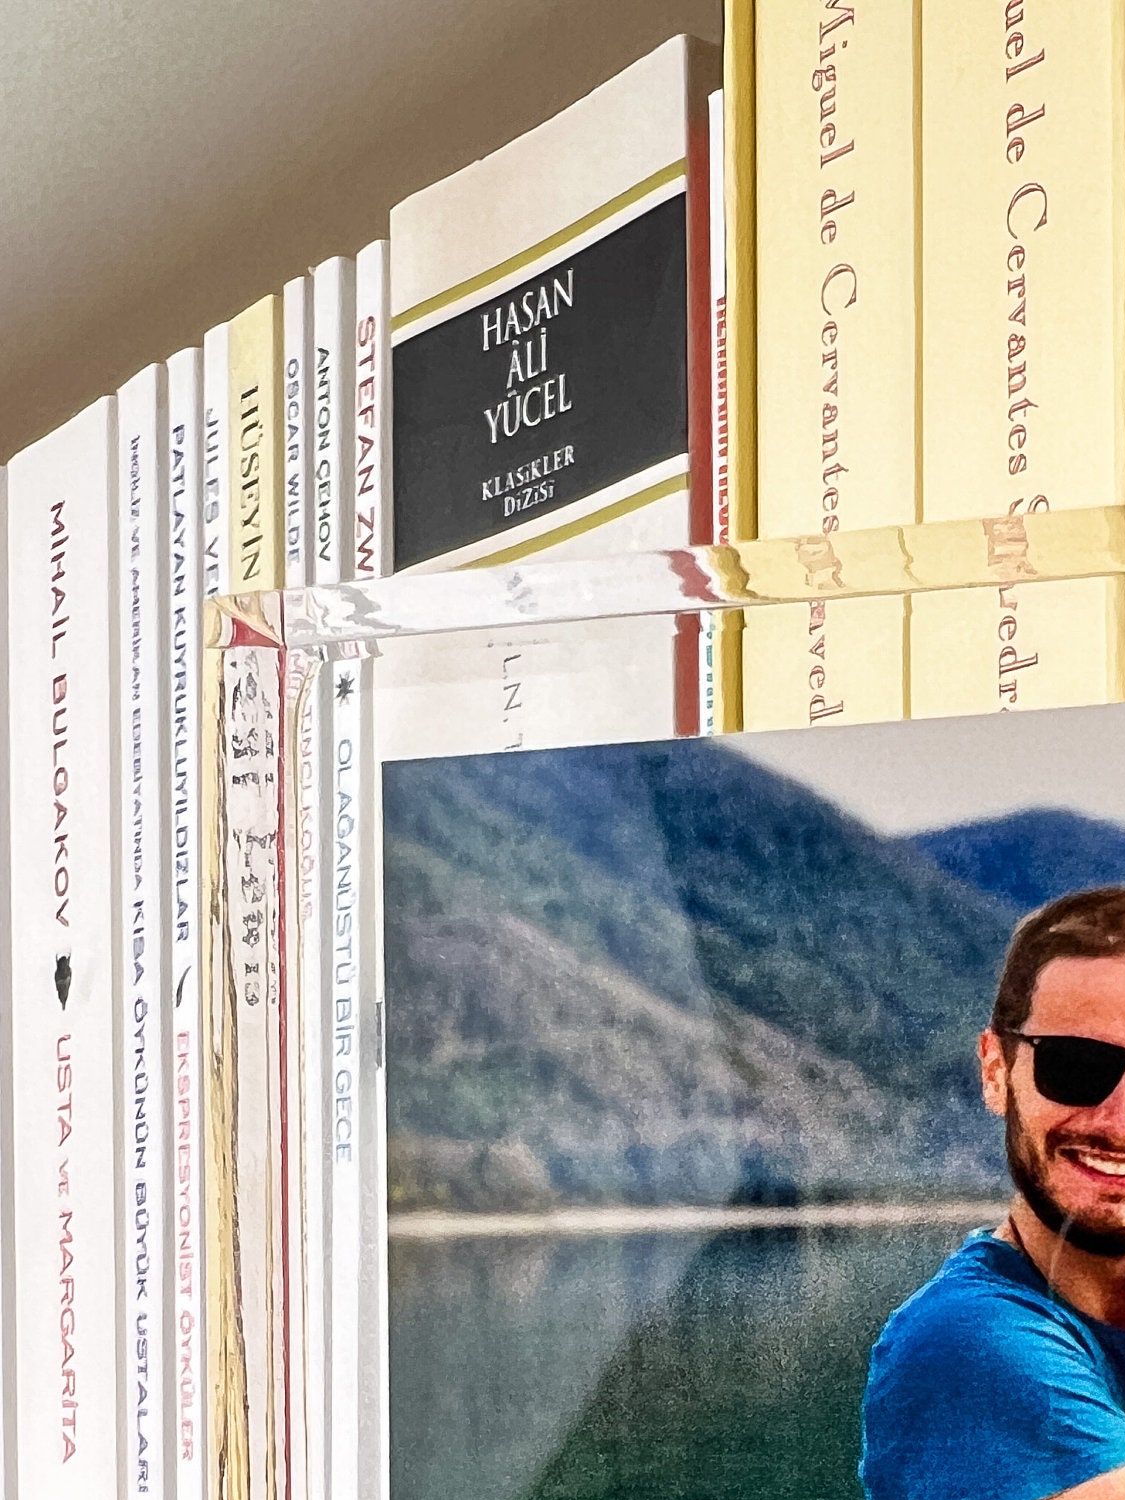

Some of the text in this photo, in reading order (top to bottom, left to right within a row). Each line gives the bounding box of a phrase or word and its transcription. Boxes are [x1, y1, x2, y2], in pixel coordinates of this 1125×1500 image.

[812, 0, 855, 169] Miguel
[1006, 103, 1046, 166] de
[819, 187, 856, 246] de
[481, 267, 575, 351] HASAN
[1006, 182, 1048, 476] Cervantes
[204, 408, 220, 525] JULES
[286, 358, 301, 566] OSCAR WILDE
[317, 347, 331, 452] ANTON
[356, 315, 376, 580] STEFAN ZW
[484, 374, 574, 444] YÜCEL
[818, 262, 858, 534] Cervantes
[172, 424, 187, 597] PATLAYAN
[52, 673, 71, 928] BULGAKOV
[54, 1033, 73, 1147] USTA
[335, 1069, 353, 1164] GECE
[56, 1210, 80, 1464] MARGARİTA
